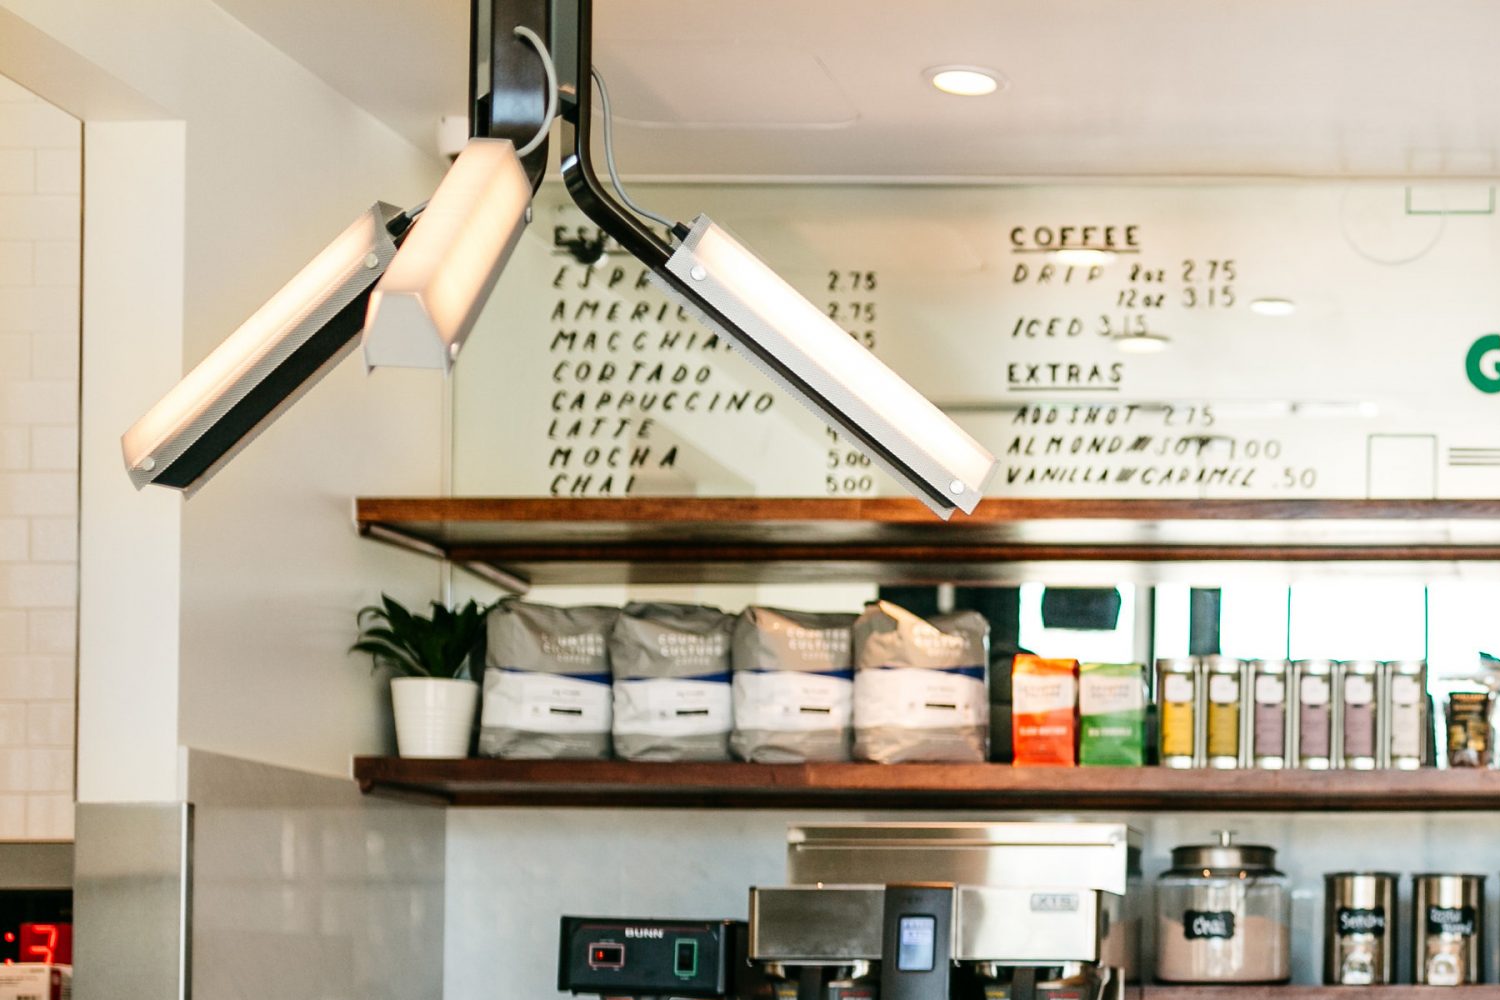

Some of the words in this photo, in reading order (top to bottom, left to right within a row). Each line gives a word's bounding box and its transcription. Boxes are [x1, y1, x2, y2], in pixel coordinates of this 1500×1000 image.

[1010, 225, 1140, 247] COFFEE
[553, 267, 650, 289] ESPR
[1012, 264, 1104, 284] DRIP
[551, 301, 692, 321] AMERIC
[1012, 317, 1083, 338] ICED
[550, 331, 722, 352] MACCHIA
[552, 363, 711, 384] CORTADO
[1007, 362, 1124, 384] EXTRAS
[551, 391, 776, 413] CAPPUCCINO
[547, 417, 653, 440] LATTE
[550, 446, 679, 468] MOCHA
[550, 474, 636, 496] CHAI
[625, 927, 664, 939] BUNN
